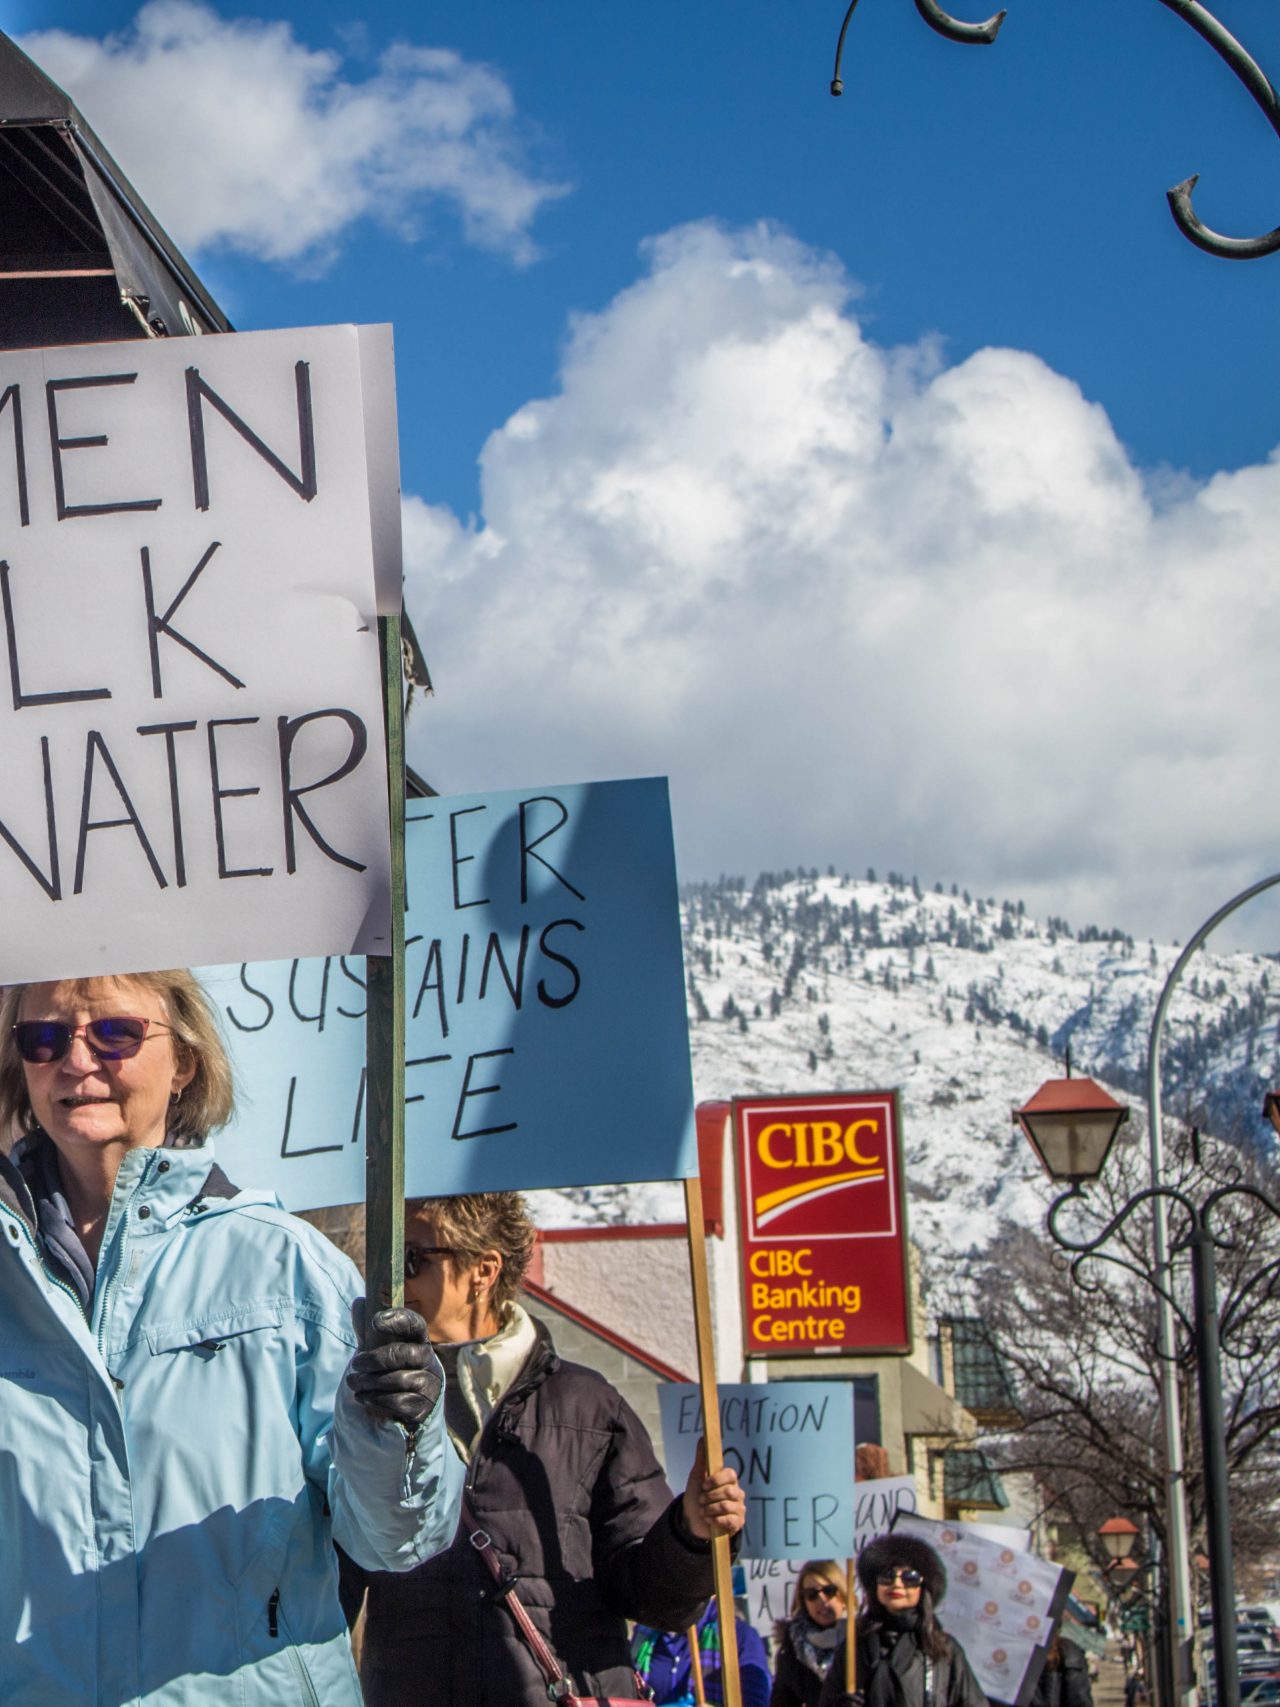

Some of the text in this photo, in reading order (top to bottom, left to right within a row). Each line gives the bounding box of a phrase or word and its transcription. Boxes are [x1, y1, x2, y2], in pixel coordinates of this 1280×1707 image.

[756, 1119, 880, 1169] CIBC
[749, 1249, 813, 1277] CIBC
[751, 1280, 861, 1313] Banking
[752, 1315, 845, 1342] Centre
[743, 1494, 839, 1548] TER
